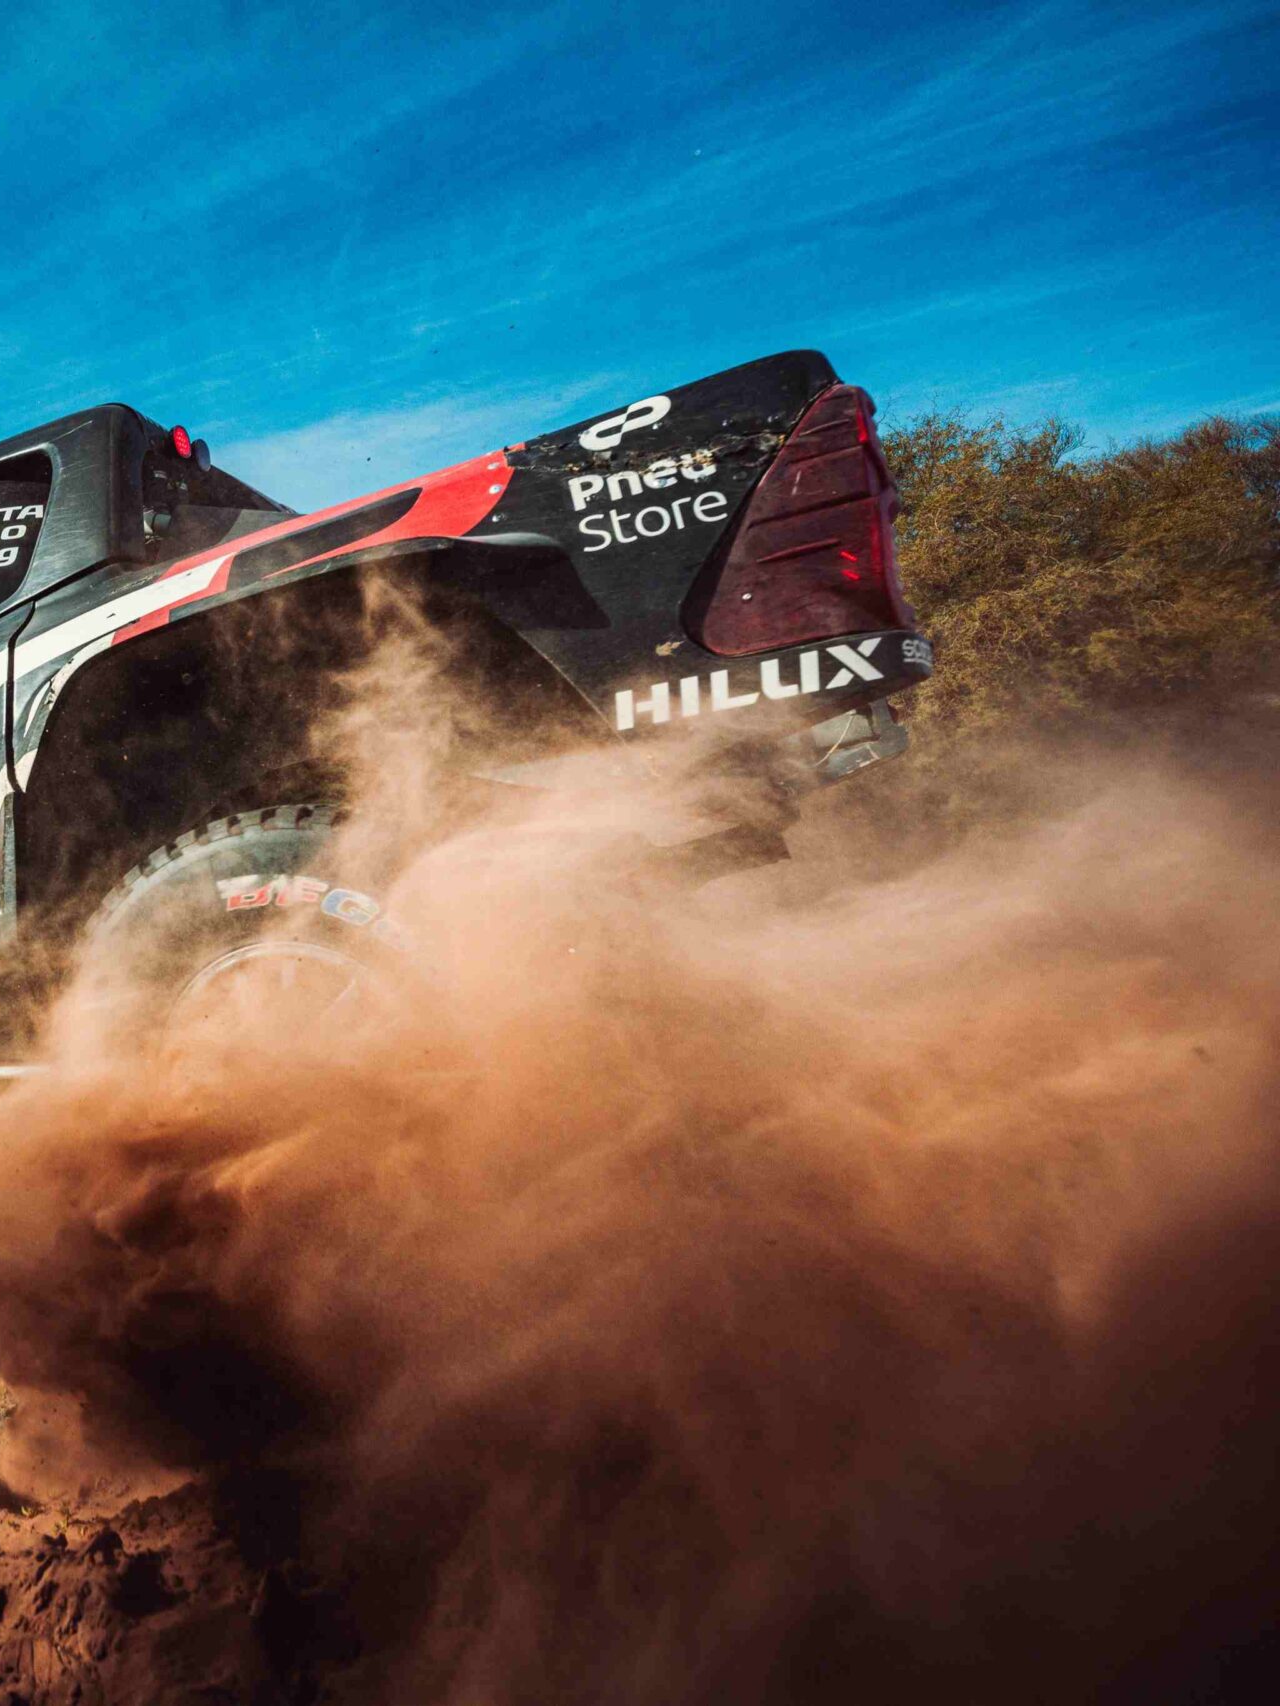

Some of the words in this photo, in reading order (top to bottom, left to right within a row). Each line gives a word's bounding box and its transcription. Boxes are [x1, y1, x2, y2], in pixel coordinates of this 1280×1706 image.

[568, 450, 719, 512] Pneu
[577, 490, 728, 553] Store
[615, 637, 884, 731] HILUX
